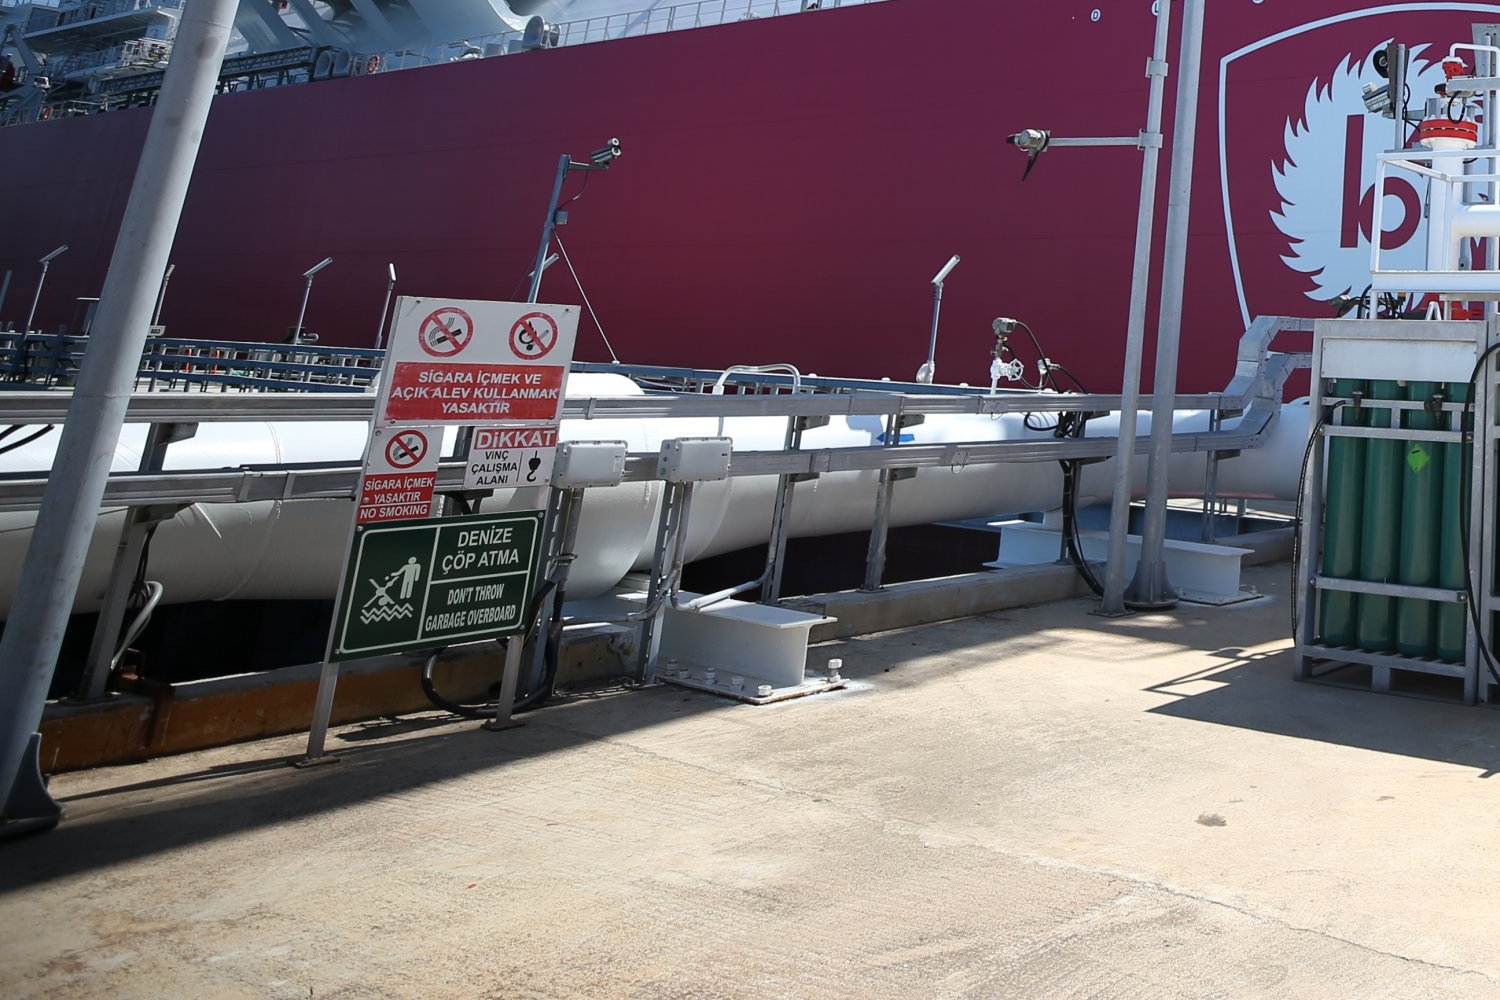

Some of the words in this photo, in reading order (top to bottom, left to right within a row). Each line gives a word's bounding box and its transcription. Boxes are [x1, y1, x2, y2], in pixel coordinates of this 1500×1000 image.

[476, 370, 521, 386] İÇMEK
[524, 373, 542, 385] VE
[391, 386, 430, 401] AÇIK
[431, 387, 471, 399] ALEV
[473, 387, 559, 399] KULLANMAK
[441, 402, 511, 414] YASAKTIR
[471, 461, 518, 474] ÇALIŞMA
[364, 477, 402, 491] SİGARA
[403, 476, 434, 490] İÇMEK
[476, 475, 508, 486] ALANI
[373, 491, 421, 504] YASAKTIR
[360, 507, 376, 519] NO
[378, 504, 428, 517] SMOKING
[457, 525, 513, 547] DENİZE
[441, 550, 476, 575] ÇÖP
[477, 548, 519, 568] ATMA
[446, 587, 474, 605] DON'T
[474, 583, 504, 602] THROW
[425, 611, 467, 632] GARBAGE
[467, 604, 516, 626] OVERBOARD
